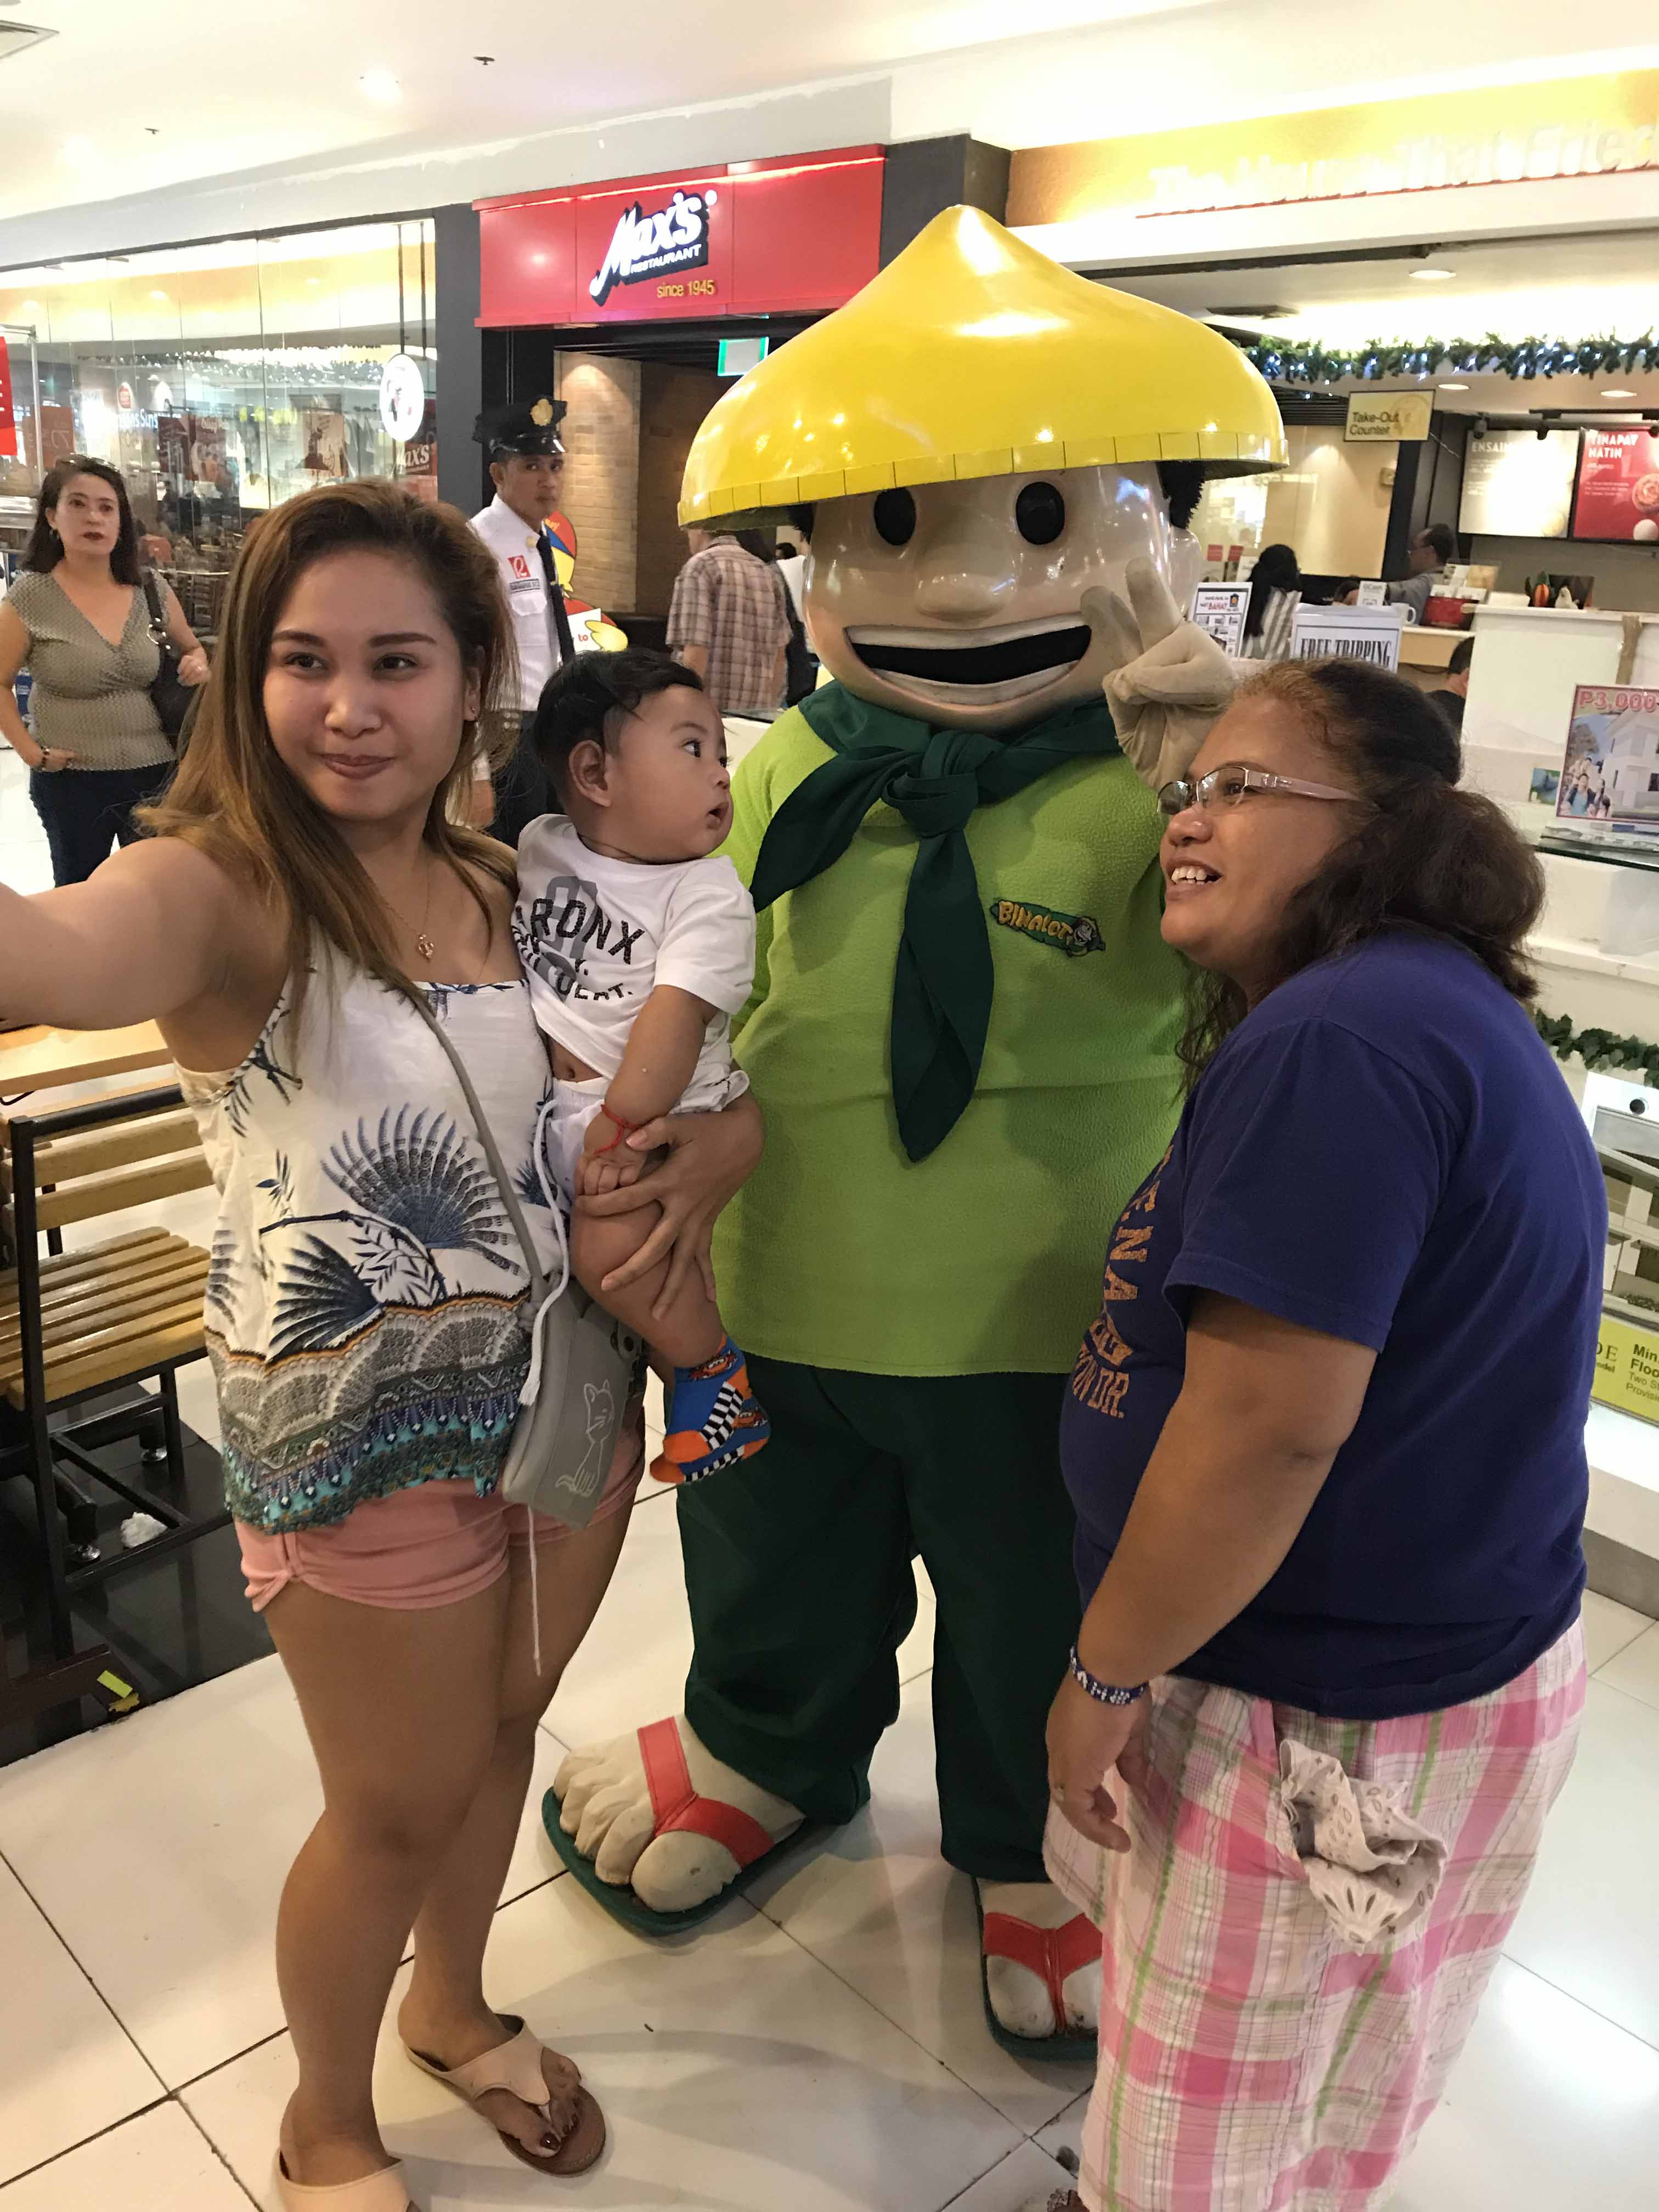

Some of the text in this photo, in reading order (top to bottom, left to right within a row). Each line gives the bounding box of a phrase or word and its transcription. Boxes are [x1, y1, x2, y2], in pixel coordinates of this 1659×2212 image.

[589, 191, 703, 297] Max's
[630, 244, 702, 274] RESTAURANT
[656, 280, 715, 298] since 1945
[1353, 411, 1400, 422] Take-Out
[1350, 424, 1390, 435] Counter
[1588, 447, 1622, 459] NATIN
[578, 633, 589, 642] to
[1300, 637, 1392, 668] FREE TRIPPING
[998, 900, 1074, 940] BINALOT
[515, 898, 645, 964] RONX
[1629, 1372, 1647, 1386] Two
